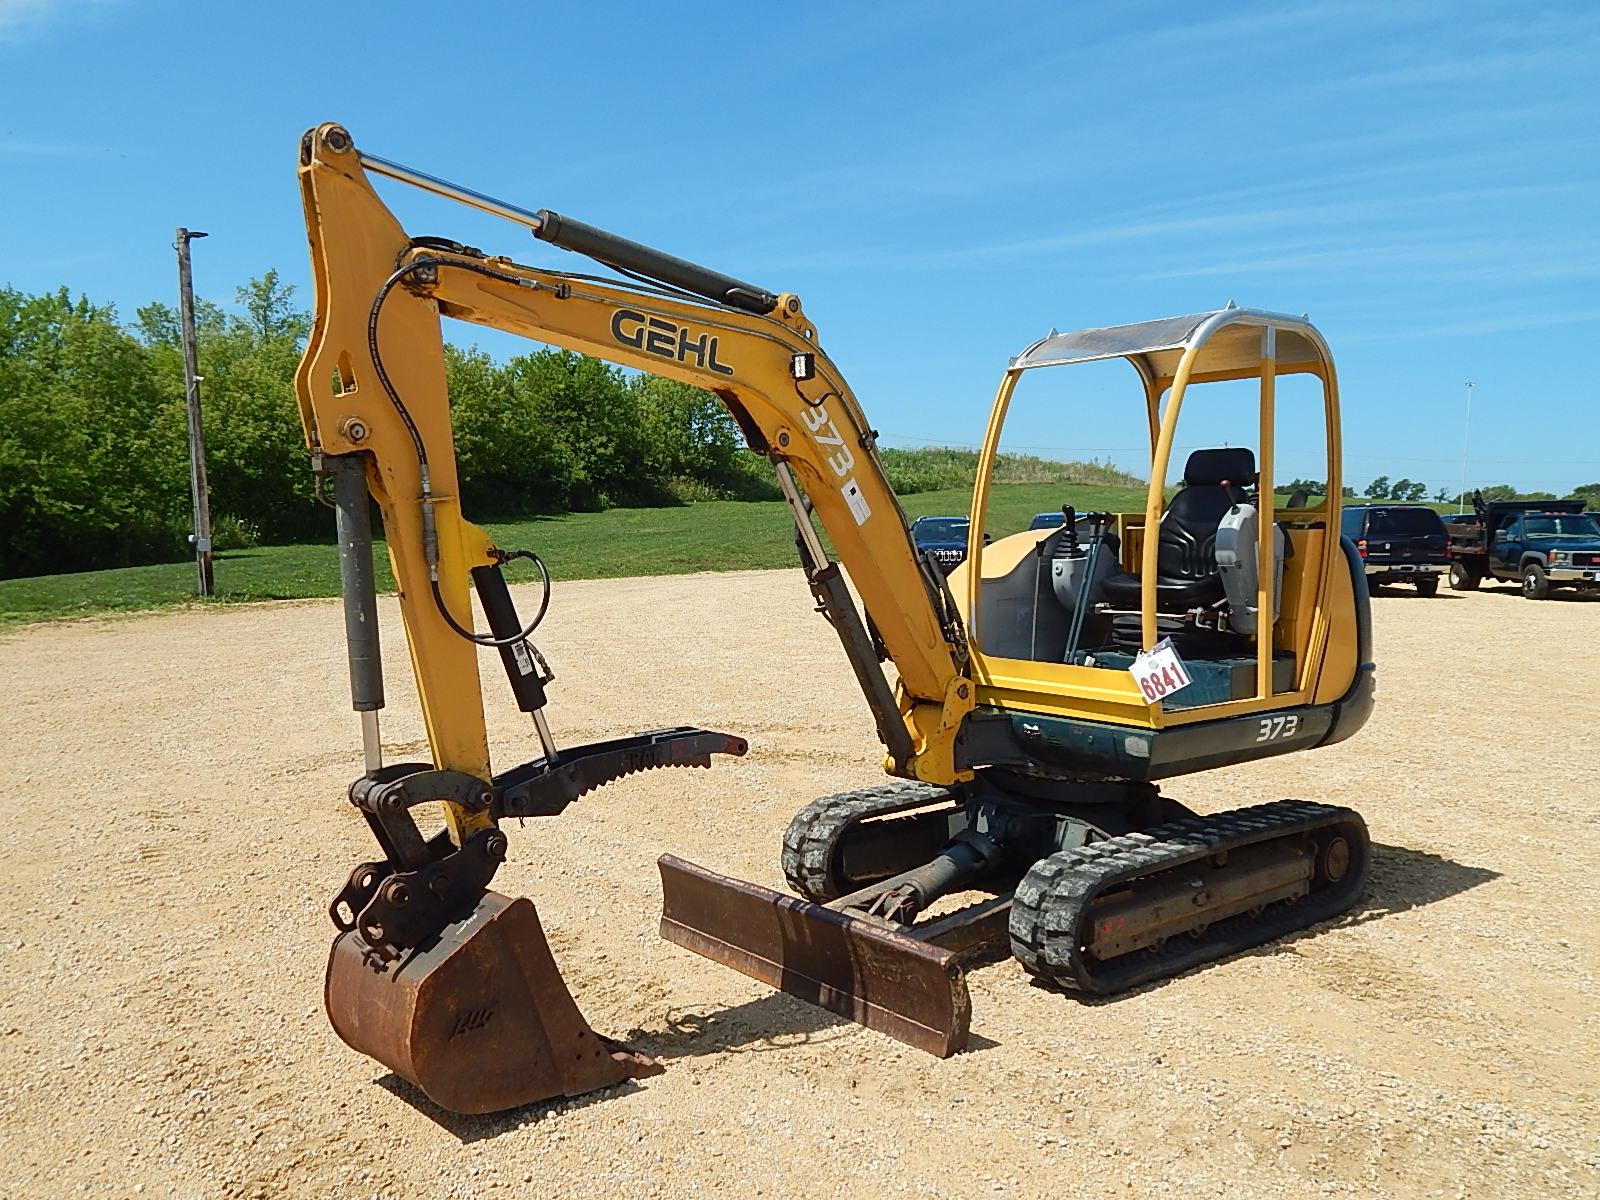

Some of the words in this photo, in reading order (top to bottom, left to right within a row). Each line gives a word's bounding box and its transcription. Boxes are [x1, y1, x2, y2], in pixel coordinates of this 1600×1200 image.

[611, 309, 734, 375] GEHL
[801, 399, 855, 477] 373
[1140, 662, 1186, 701] 6841
[1256, 715, 1299, 742] 373
